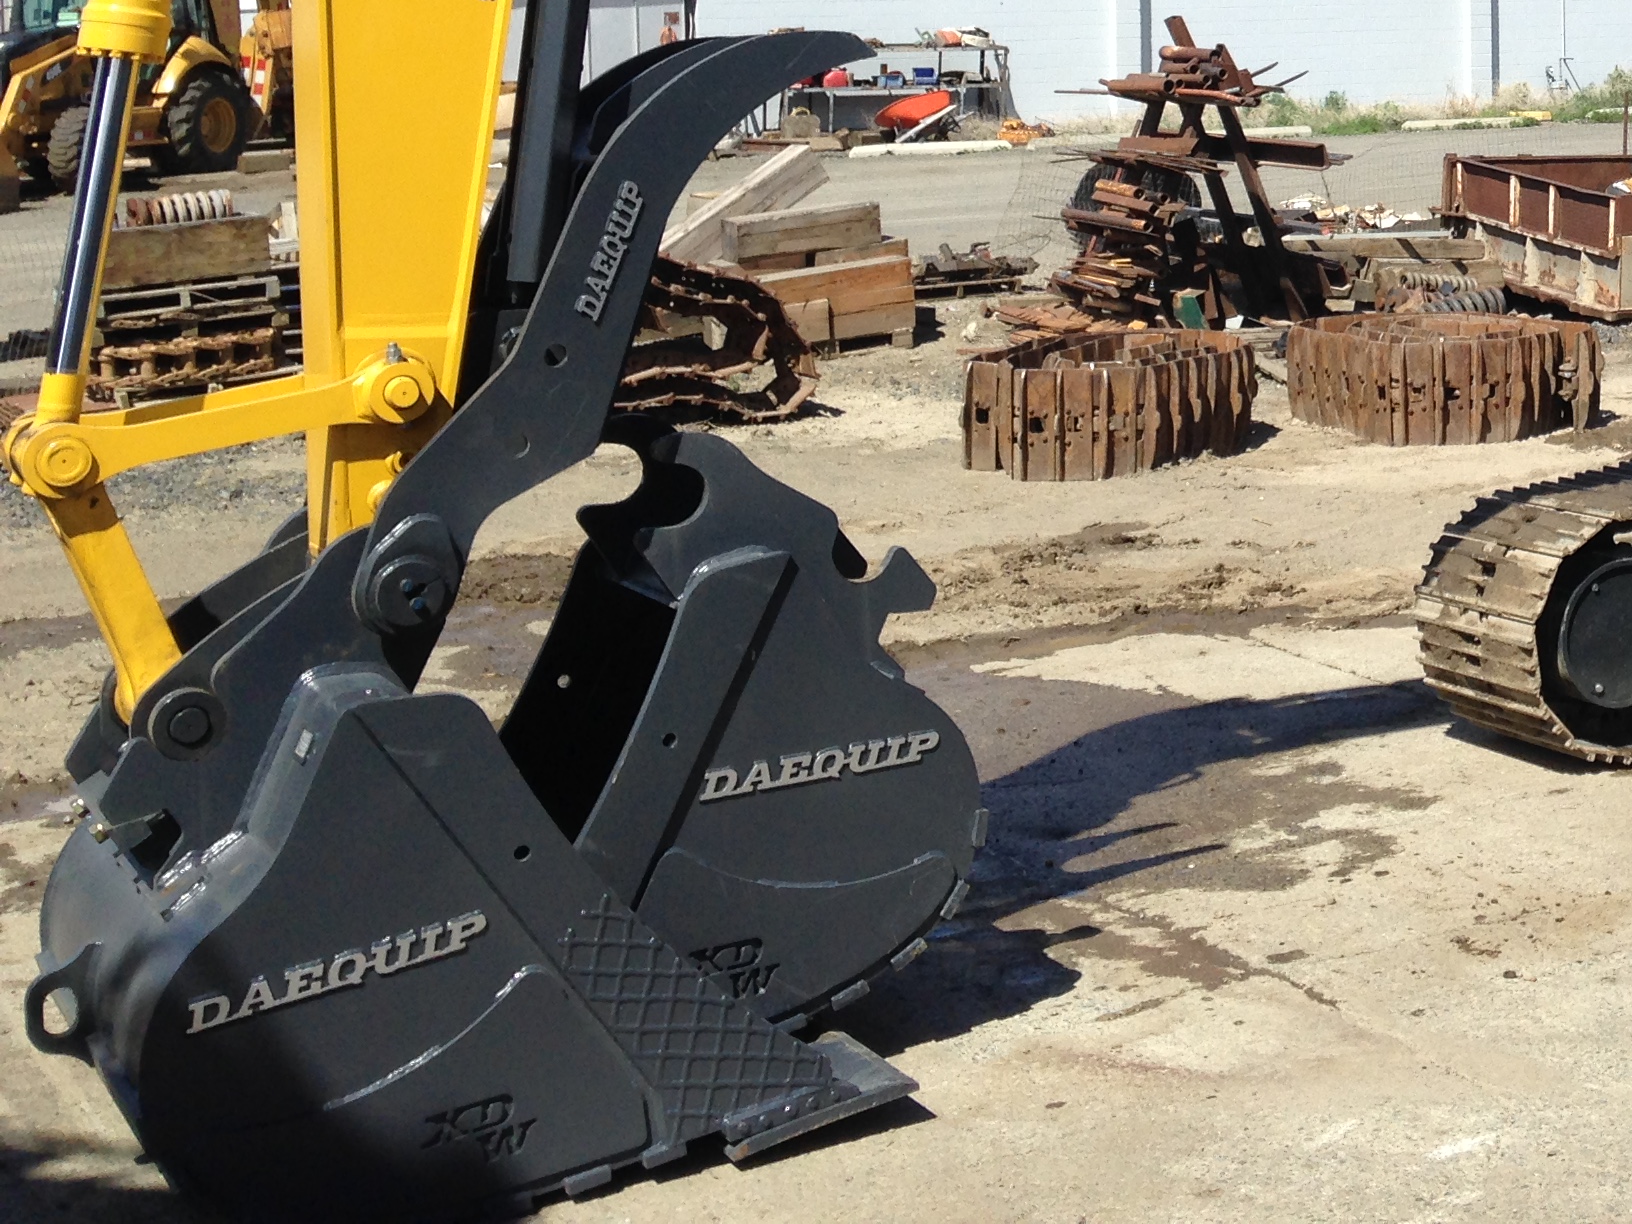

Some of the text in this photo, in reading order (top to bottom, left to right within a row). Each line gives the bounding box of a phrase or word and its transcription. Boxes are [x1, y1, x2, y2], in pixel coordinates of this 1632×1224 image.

[574, 180, 643, 322] DAEQUIP
[699, 729, 940, 801] DAEQUIP
[187, 909, 487, 1034] DAEQUIP
